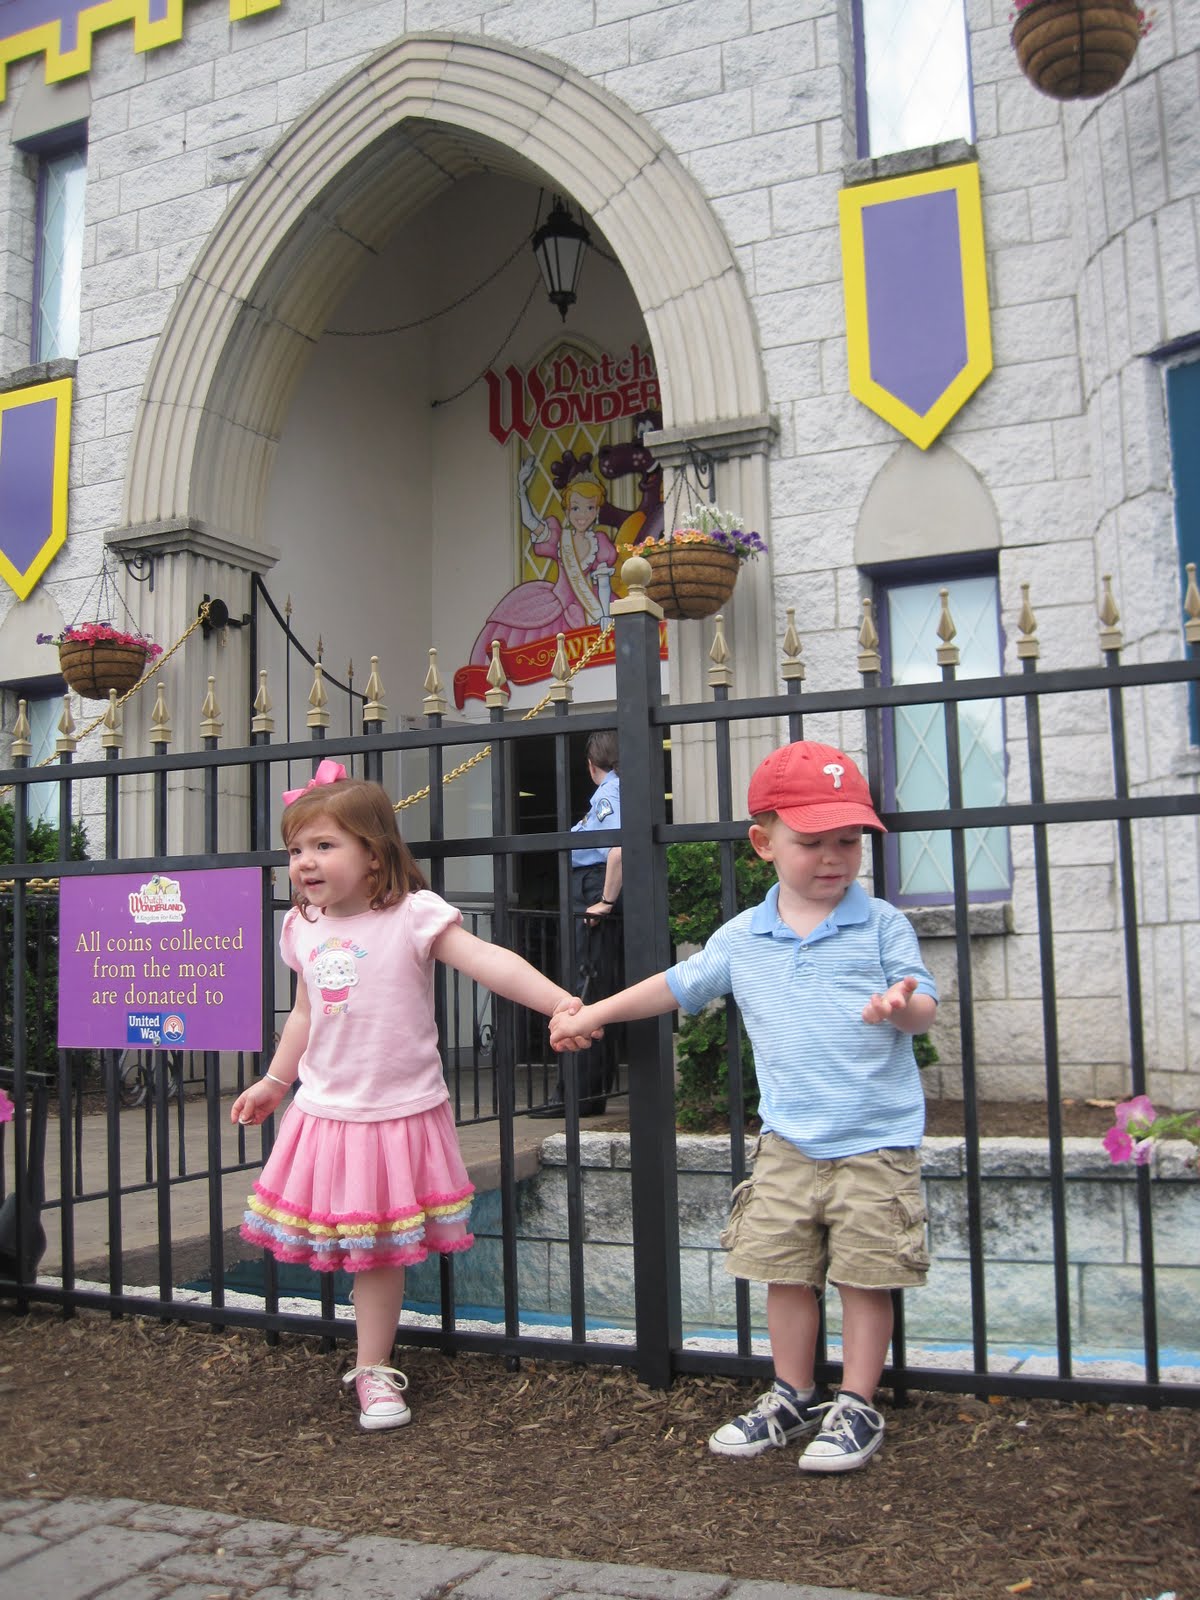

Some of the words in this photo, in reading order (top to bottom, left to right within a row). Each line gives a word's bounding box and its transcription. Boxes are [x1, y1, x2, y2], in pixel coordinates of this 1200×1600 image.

[551, 344, 652, 394] Dutch
[130, 895, 184, 914] WONDERLAND
[75, 930, 101, 952] All
[106, 930, 153, 952] coins
[160, 927, 244, 951] collected
[93, 956, 136, 978] from
[143, 955, 171, 978] the
[178, 961, 226, 978] moat
[92, 990, 118, 1005] are
[124, 982, 198, 1005] donated
[205, 989, 224, 1005] to
[128, 1015, 160, 1027] United
[140, 1027, 160, 1041] Way
